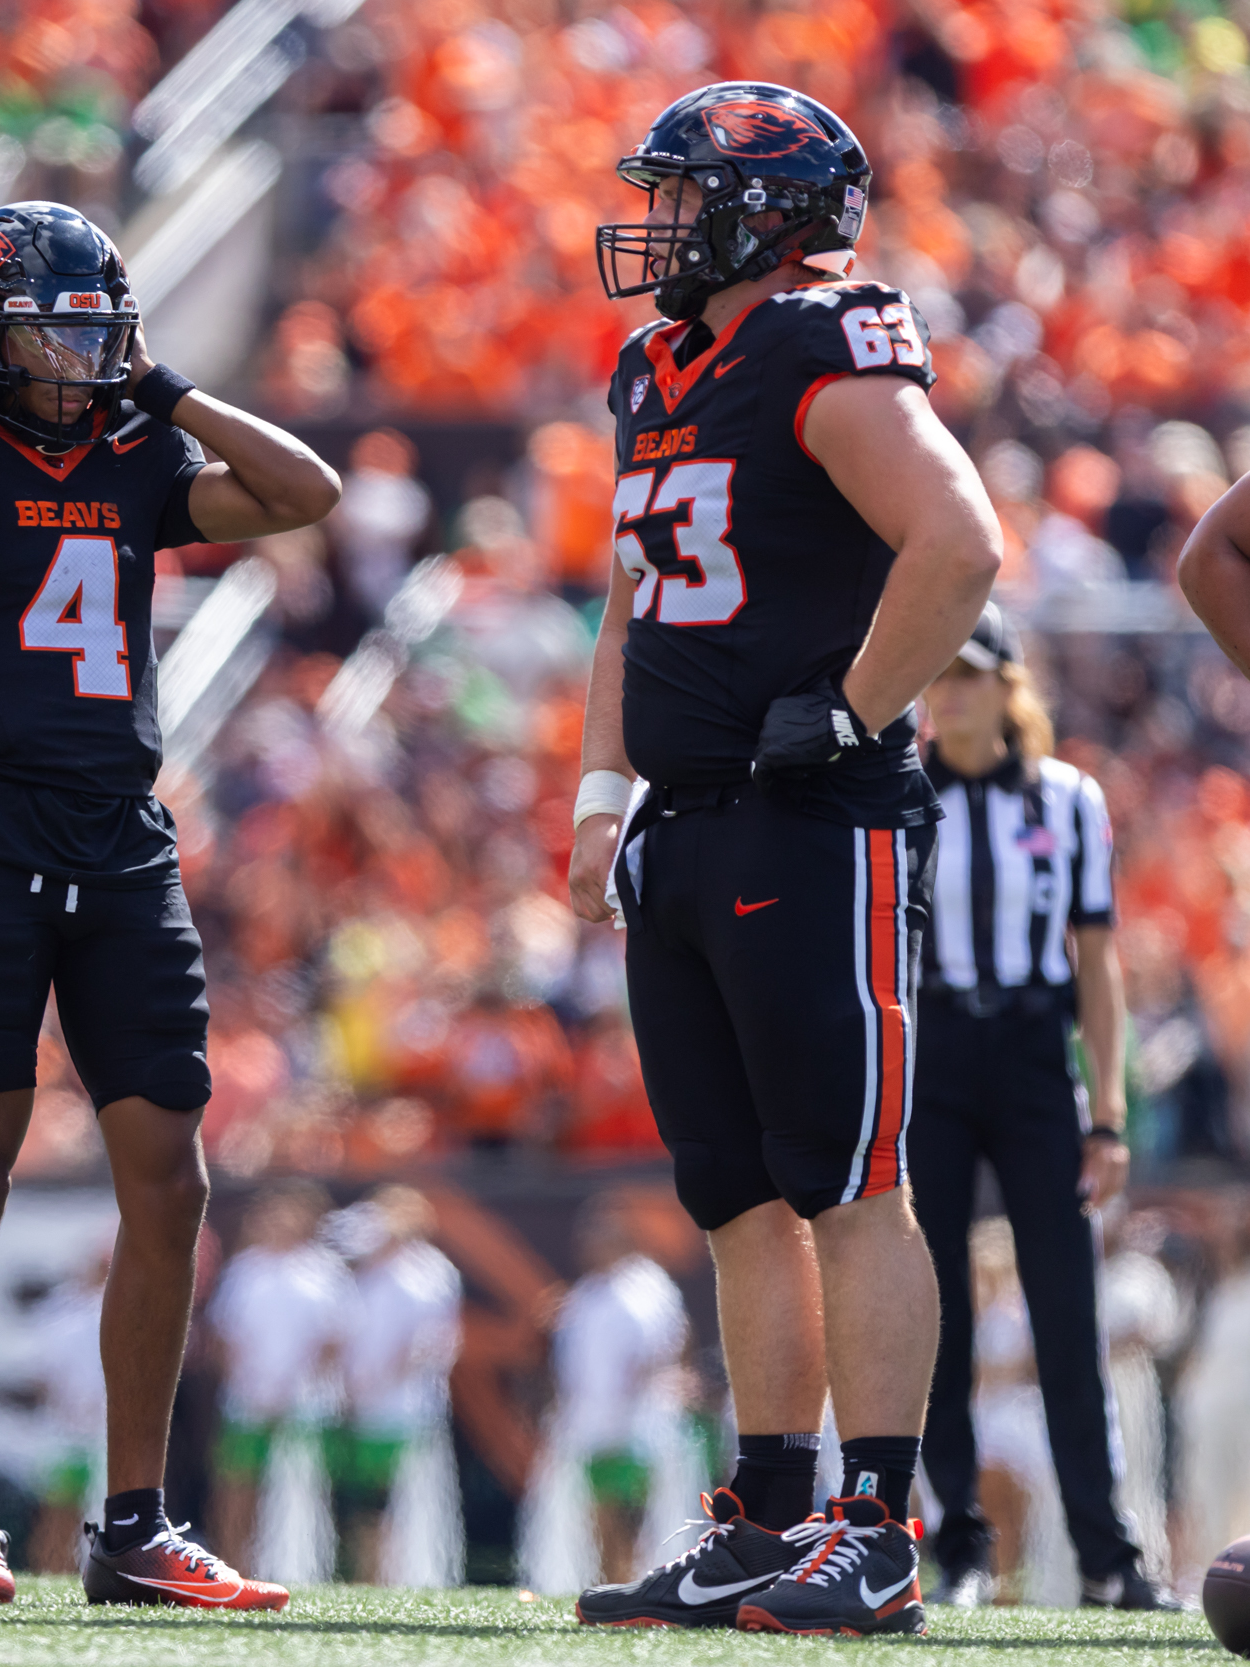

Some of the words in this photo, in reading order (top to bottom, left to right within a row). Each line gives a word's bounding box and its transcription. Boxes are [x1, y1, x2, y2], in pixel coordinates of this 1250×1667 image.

[7, 301, 34, 309] BEAVS
[69, 293, 102, 309] OSU
[839, 303, 926, 371] 63
[632, 425, 698, 462] BEAVS
[15, 500, 122, 529] BEAVS
[612, 458, 749, 627] 63
[18, 534, 133, 701] 4
[831, 709, 860, 747] NIKE
